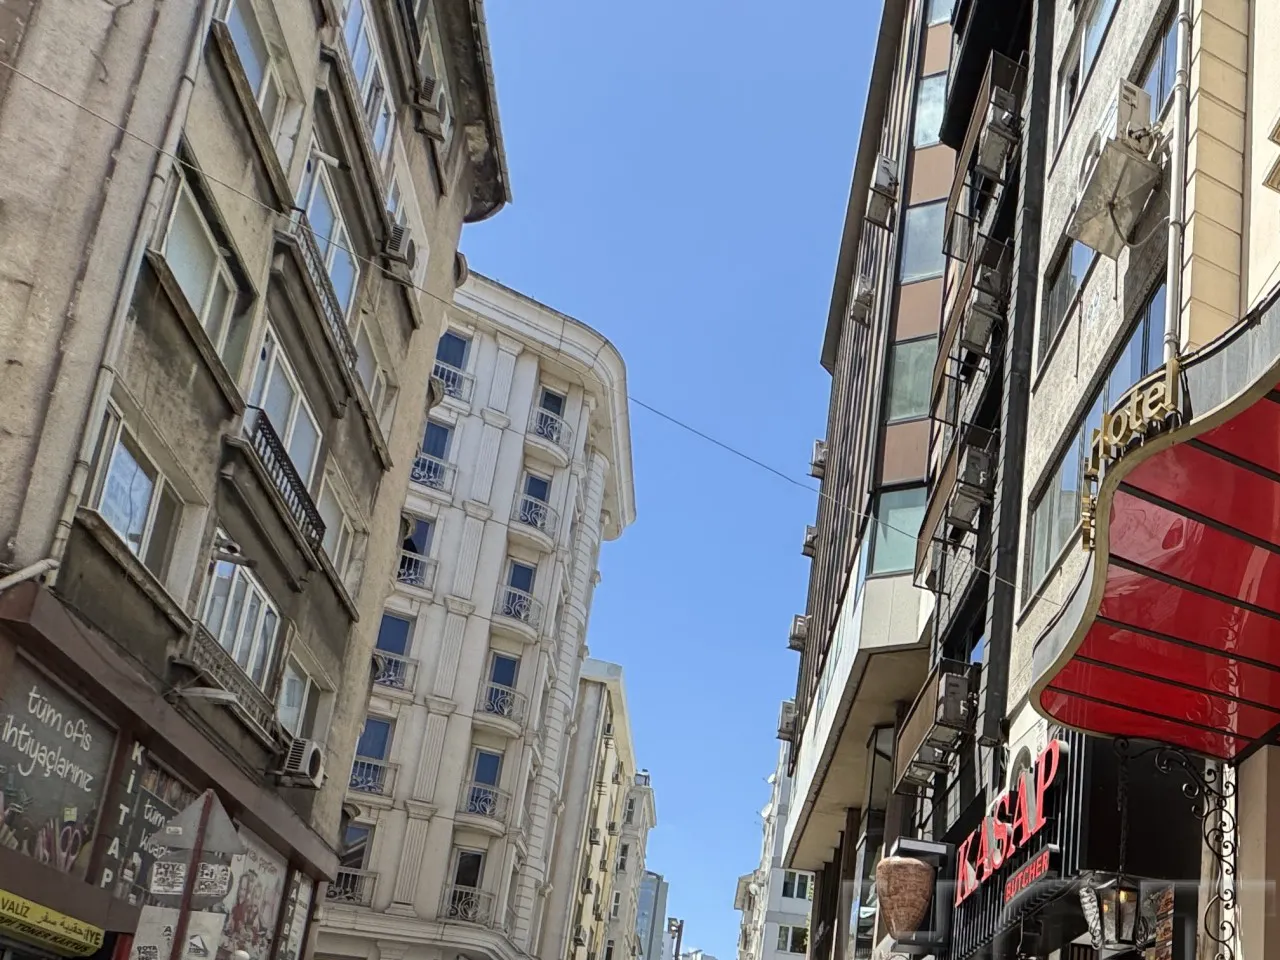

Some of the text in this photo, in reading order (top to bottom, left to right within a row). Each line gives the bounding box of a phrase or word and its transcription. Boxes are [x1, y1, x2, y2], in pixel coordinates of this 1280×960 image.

[1088, 358, 1180, 475] Hotel
[28, 685, 92, 751] tüm ofis
[955, 739, 1060, 907] KASAP
[1005, 850, 1050, 900] BUTCHER
[1, 897, 31, 918] VALİZ
[16, 922, 51, 939] TONER
